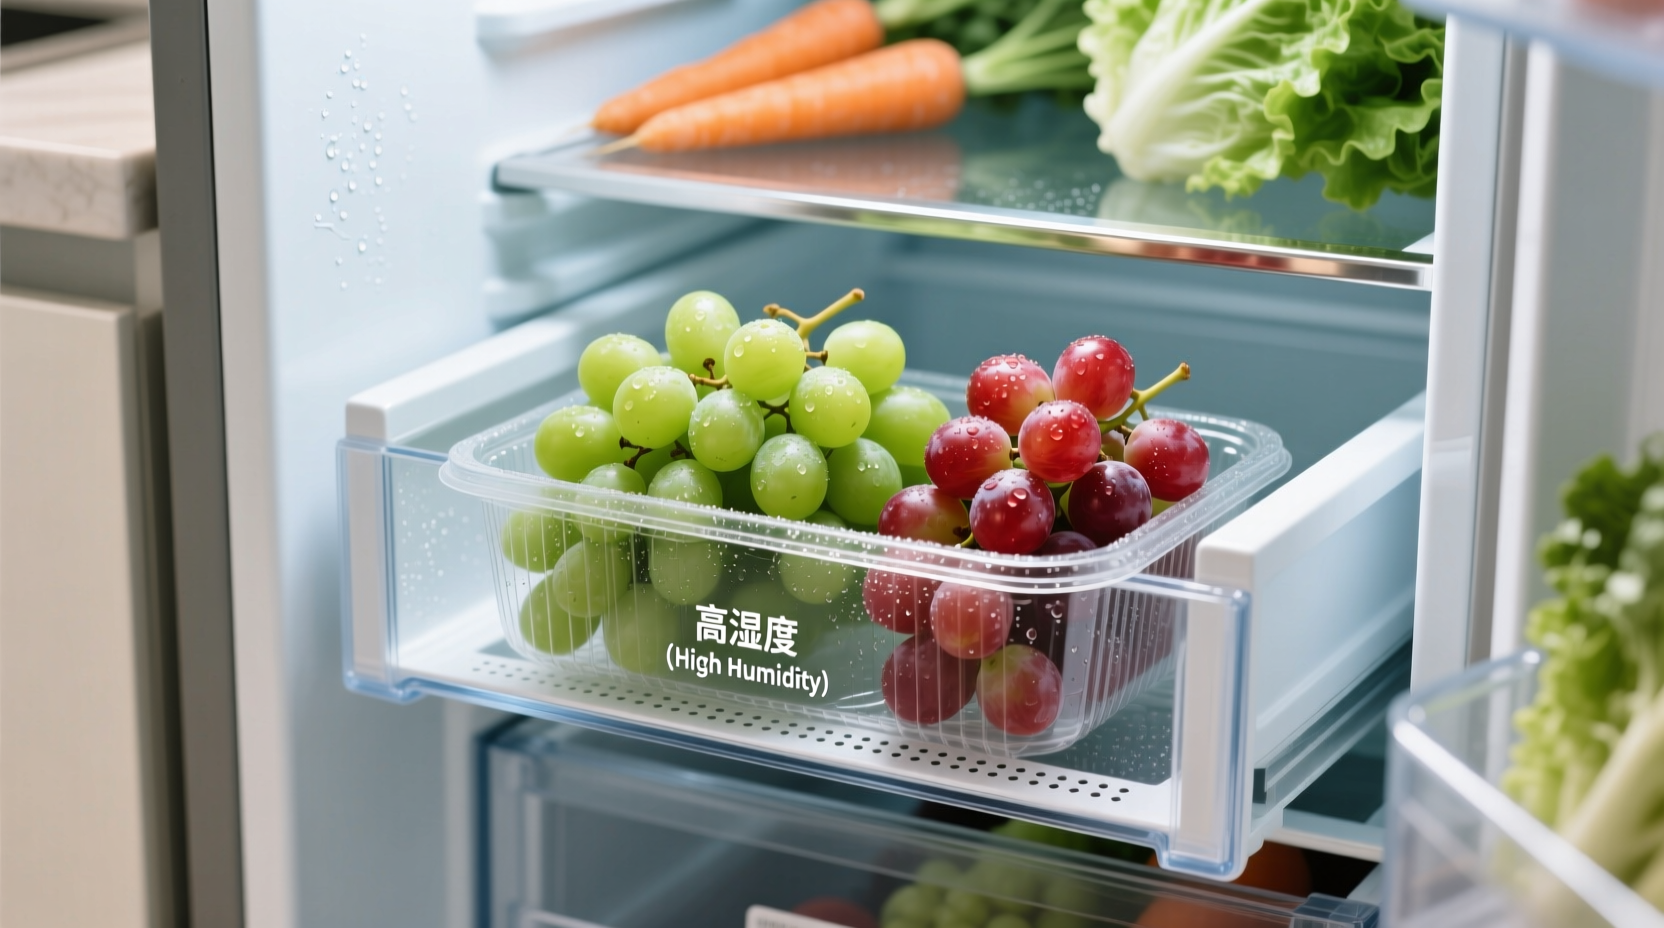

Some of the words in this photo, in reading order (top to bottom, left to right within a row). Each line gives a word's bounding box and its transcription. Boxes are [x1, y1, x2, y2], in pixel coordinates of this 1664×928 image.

[695, 604, 798, 657] 高湿度
[666, 643, 722, 678] (High
[728, 657, 829, 697] Humidity)
